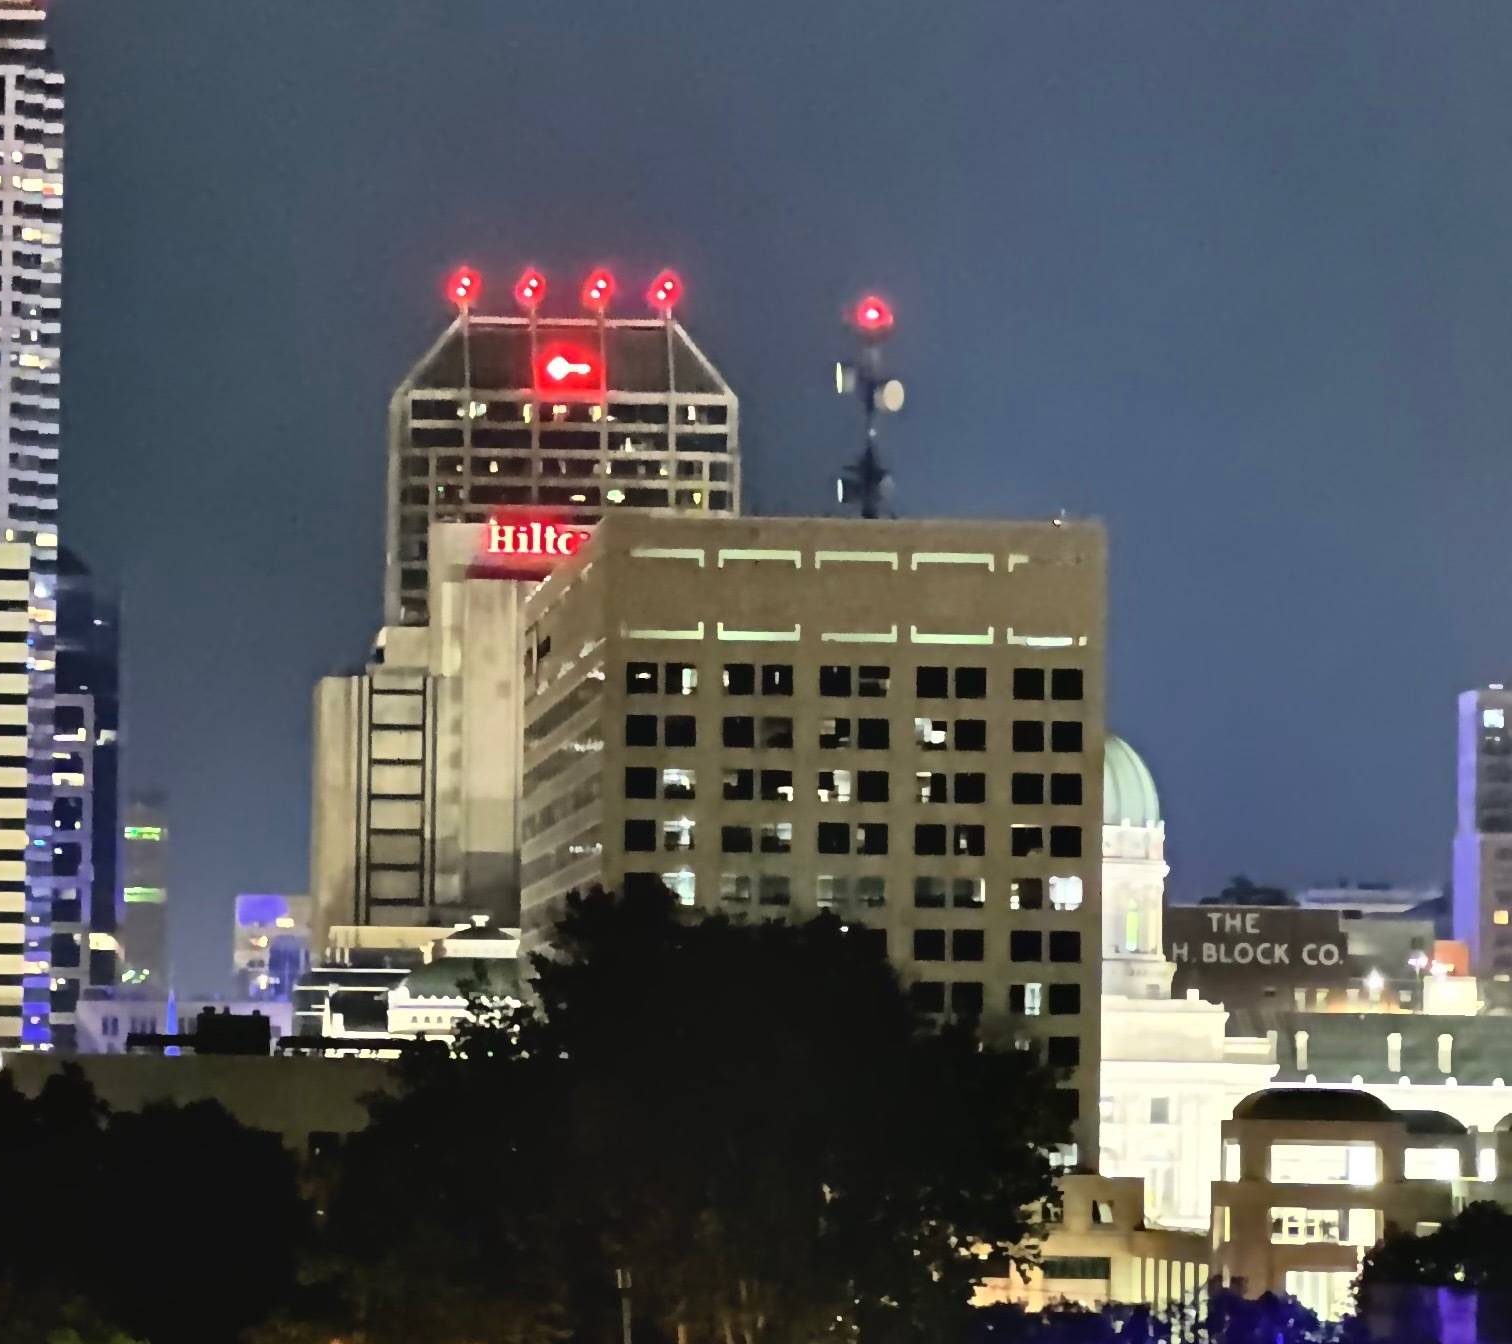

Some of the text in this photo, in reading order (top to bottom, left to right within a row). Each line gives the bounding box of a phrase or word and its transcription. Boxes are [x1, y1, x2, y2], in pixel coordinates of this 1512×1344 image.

[1207, 912, 1260, 934] THE
[1202, 942, 1290, 964] BLOCK
[1302, 943, 1344, 965] CO.
